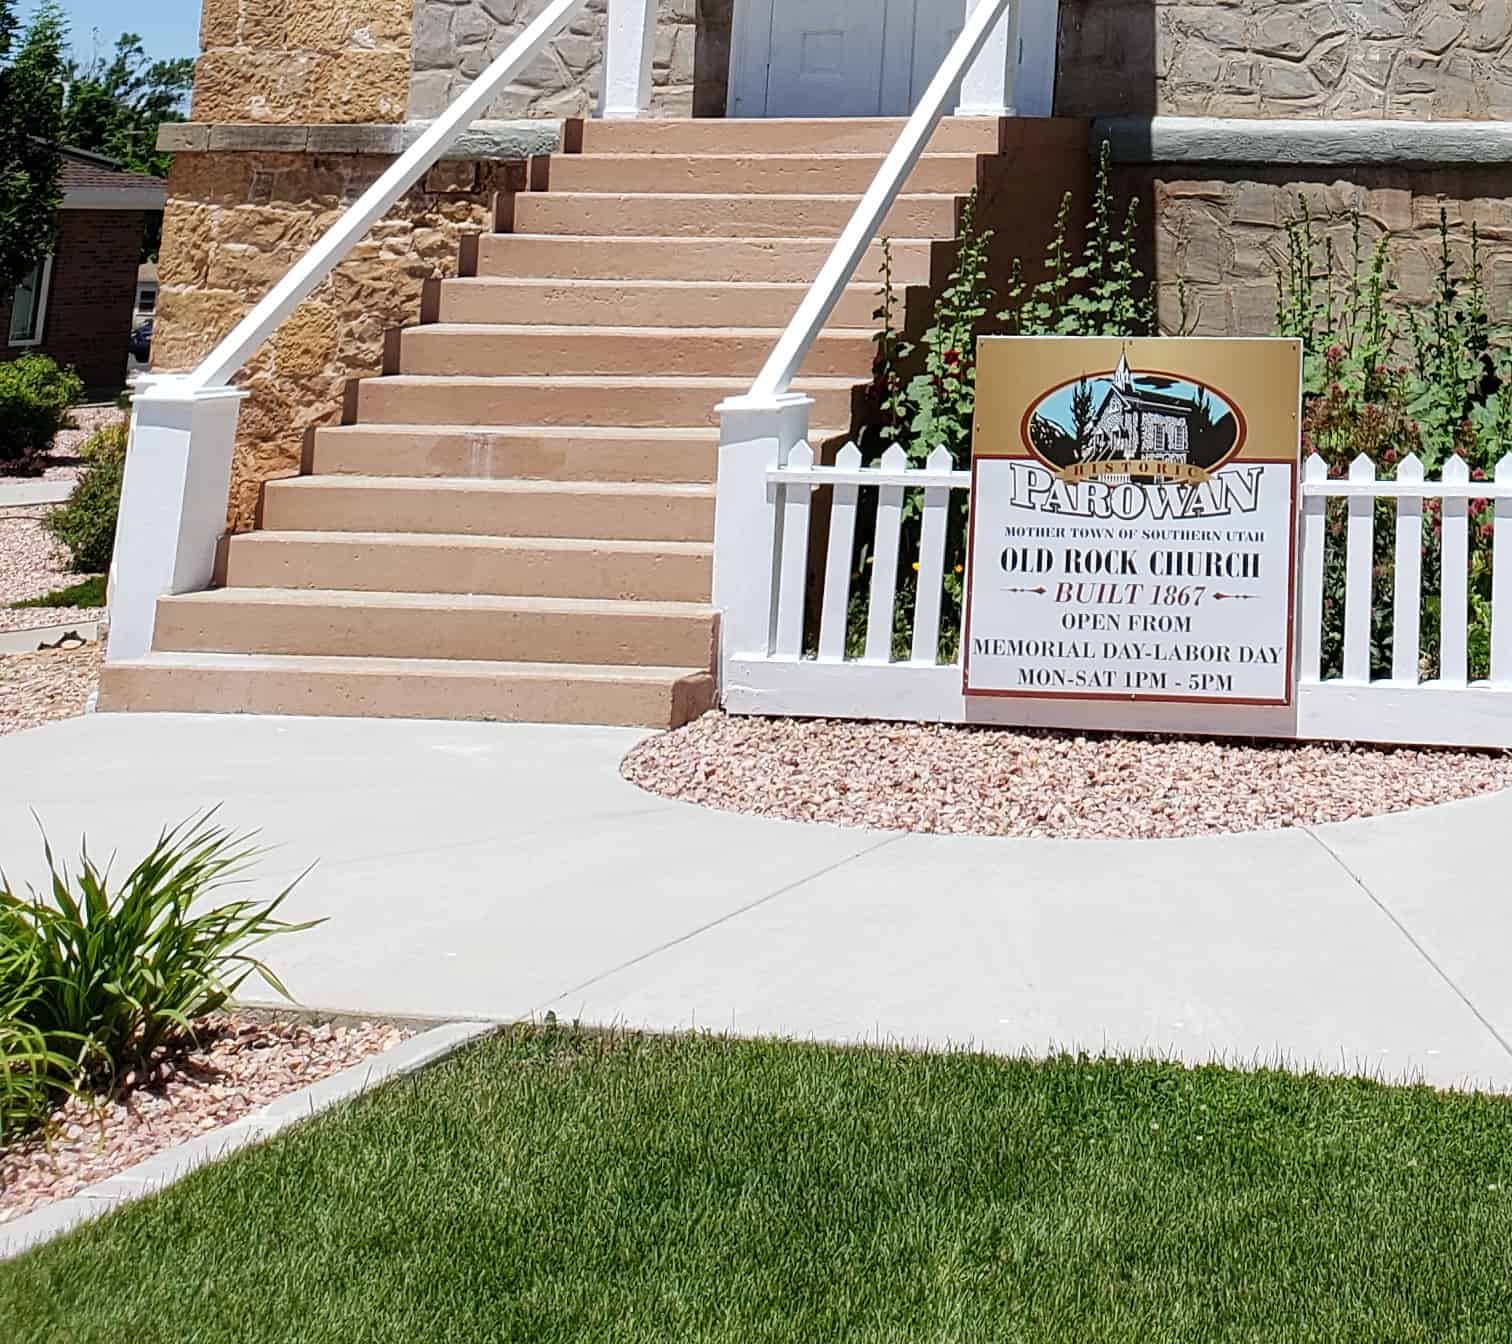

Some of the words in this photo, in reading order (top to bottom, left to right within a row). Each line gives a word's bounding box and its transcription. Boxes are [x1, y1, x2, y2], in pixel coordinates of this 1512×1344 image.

[1073, 463, 1197, 477] HISTORIC
[1010, 464, 1264, 520] PAROWAN
[1005, 527, 1065, 538] MOTHER
[1070, 528, 1113, 539] TOWN
[1118, 529, 1138, 540] OF
[1141, 530, 1222, 542] SOUTHERN
[1226, 531, 1265, 542] UTAH
[1001, 547, 1053, 574] OLD
[1064, 550, 1137, 575] ROCK
[1150, 551, 1260, 578] CHURCH
[1055, 583, 1145, 604] BUILT
[1151, 585, 1207, 607] 1867
[1062, 613, 1121, 631] OPEN
[1128, 615, 1192, 633] FROM
[973, 639, 1095, 659] MEMORIAL
[1103, 642, 1231, 663] DAY-LABOR
[1239, 646, 1282, 664] DAY
[1017, 669, 1117, 687] MON-SAT
[1123, 671, 1168, 689] 1PM
[1188, 674, 1233, 691] 5PM
